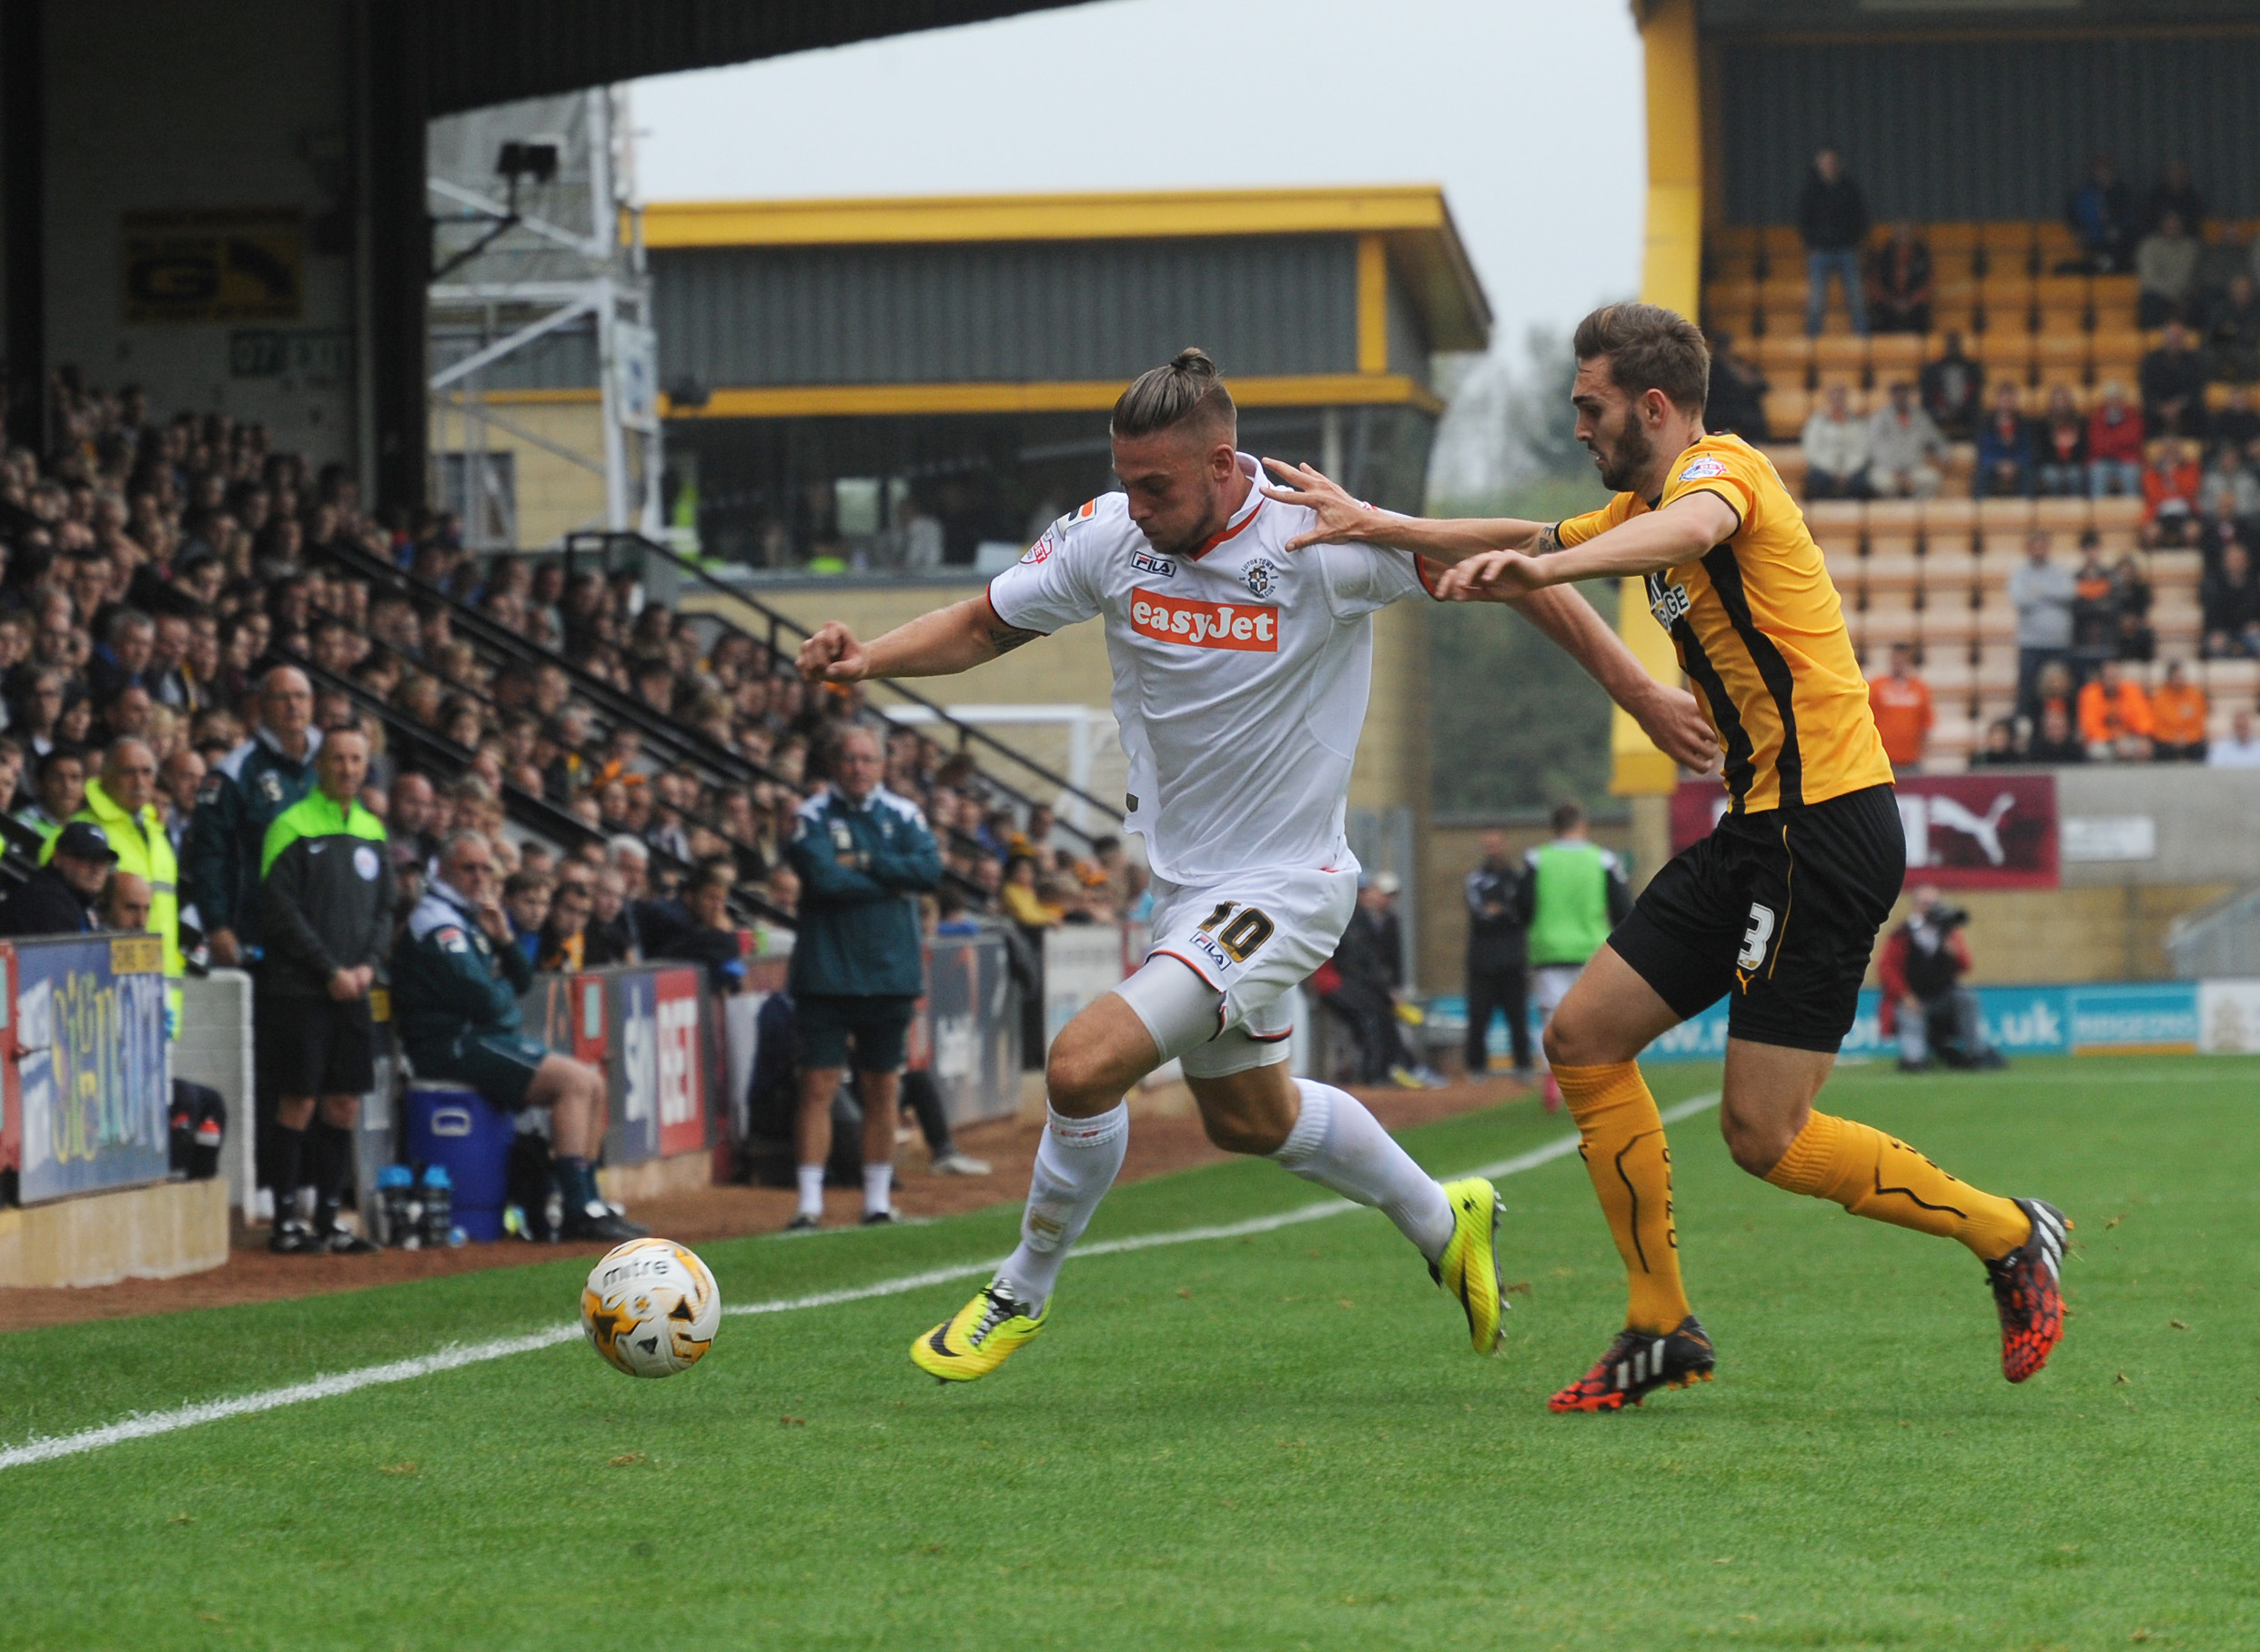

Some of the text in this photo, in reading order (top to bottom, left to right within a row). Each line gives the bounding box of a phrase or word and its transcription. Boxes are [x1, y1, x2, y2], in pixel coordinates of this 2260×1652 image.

[1136, 555, 1170, 573] FILA
[1241, 559, 1275, 572] LUTON TOWN
[1133, 601, 1274, 642] easyJet
[1196, 901, 1275, 962] 10
[1737, 902, 1775, 971] 3
[1195, 935, 1225, 965] FILA
